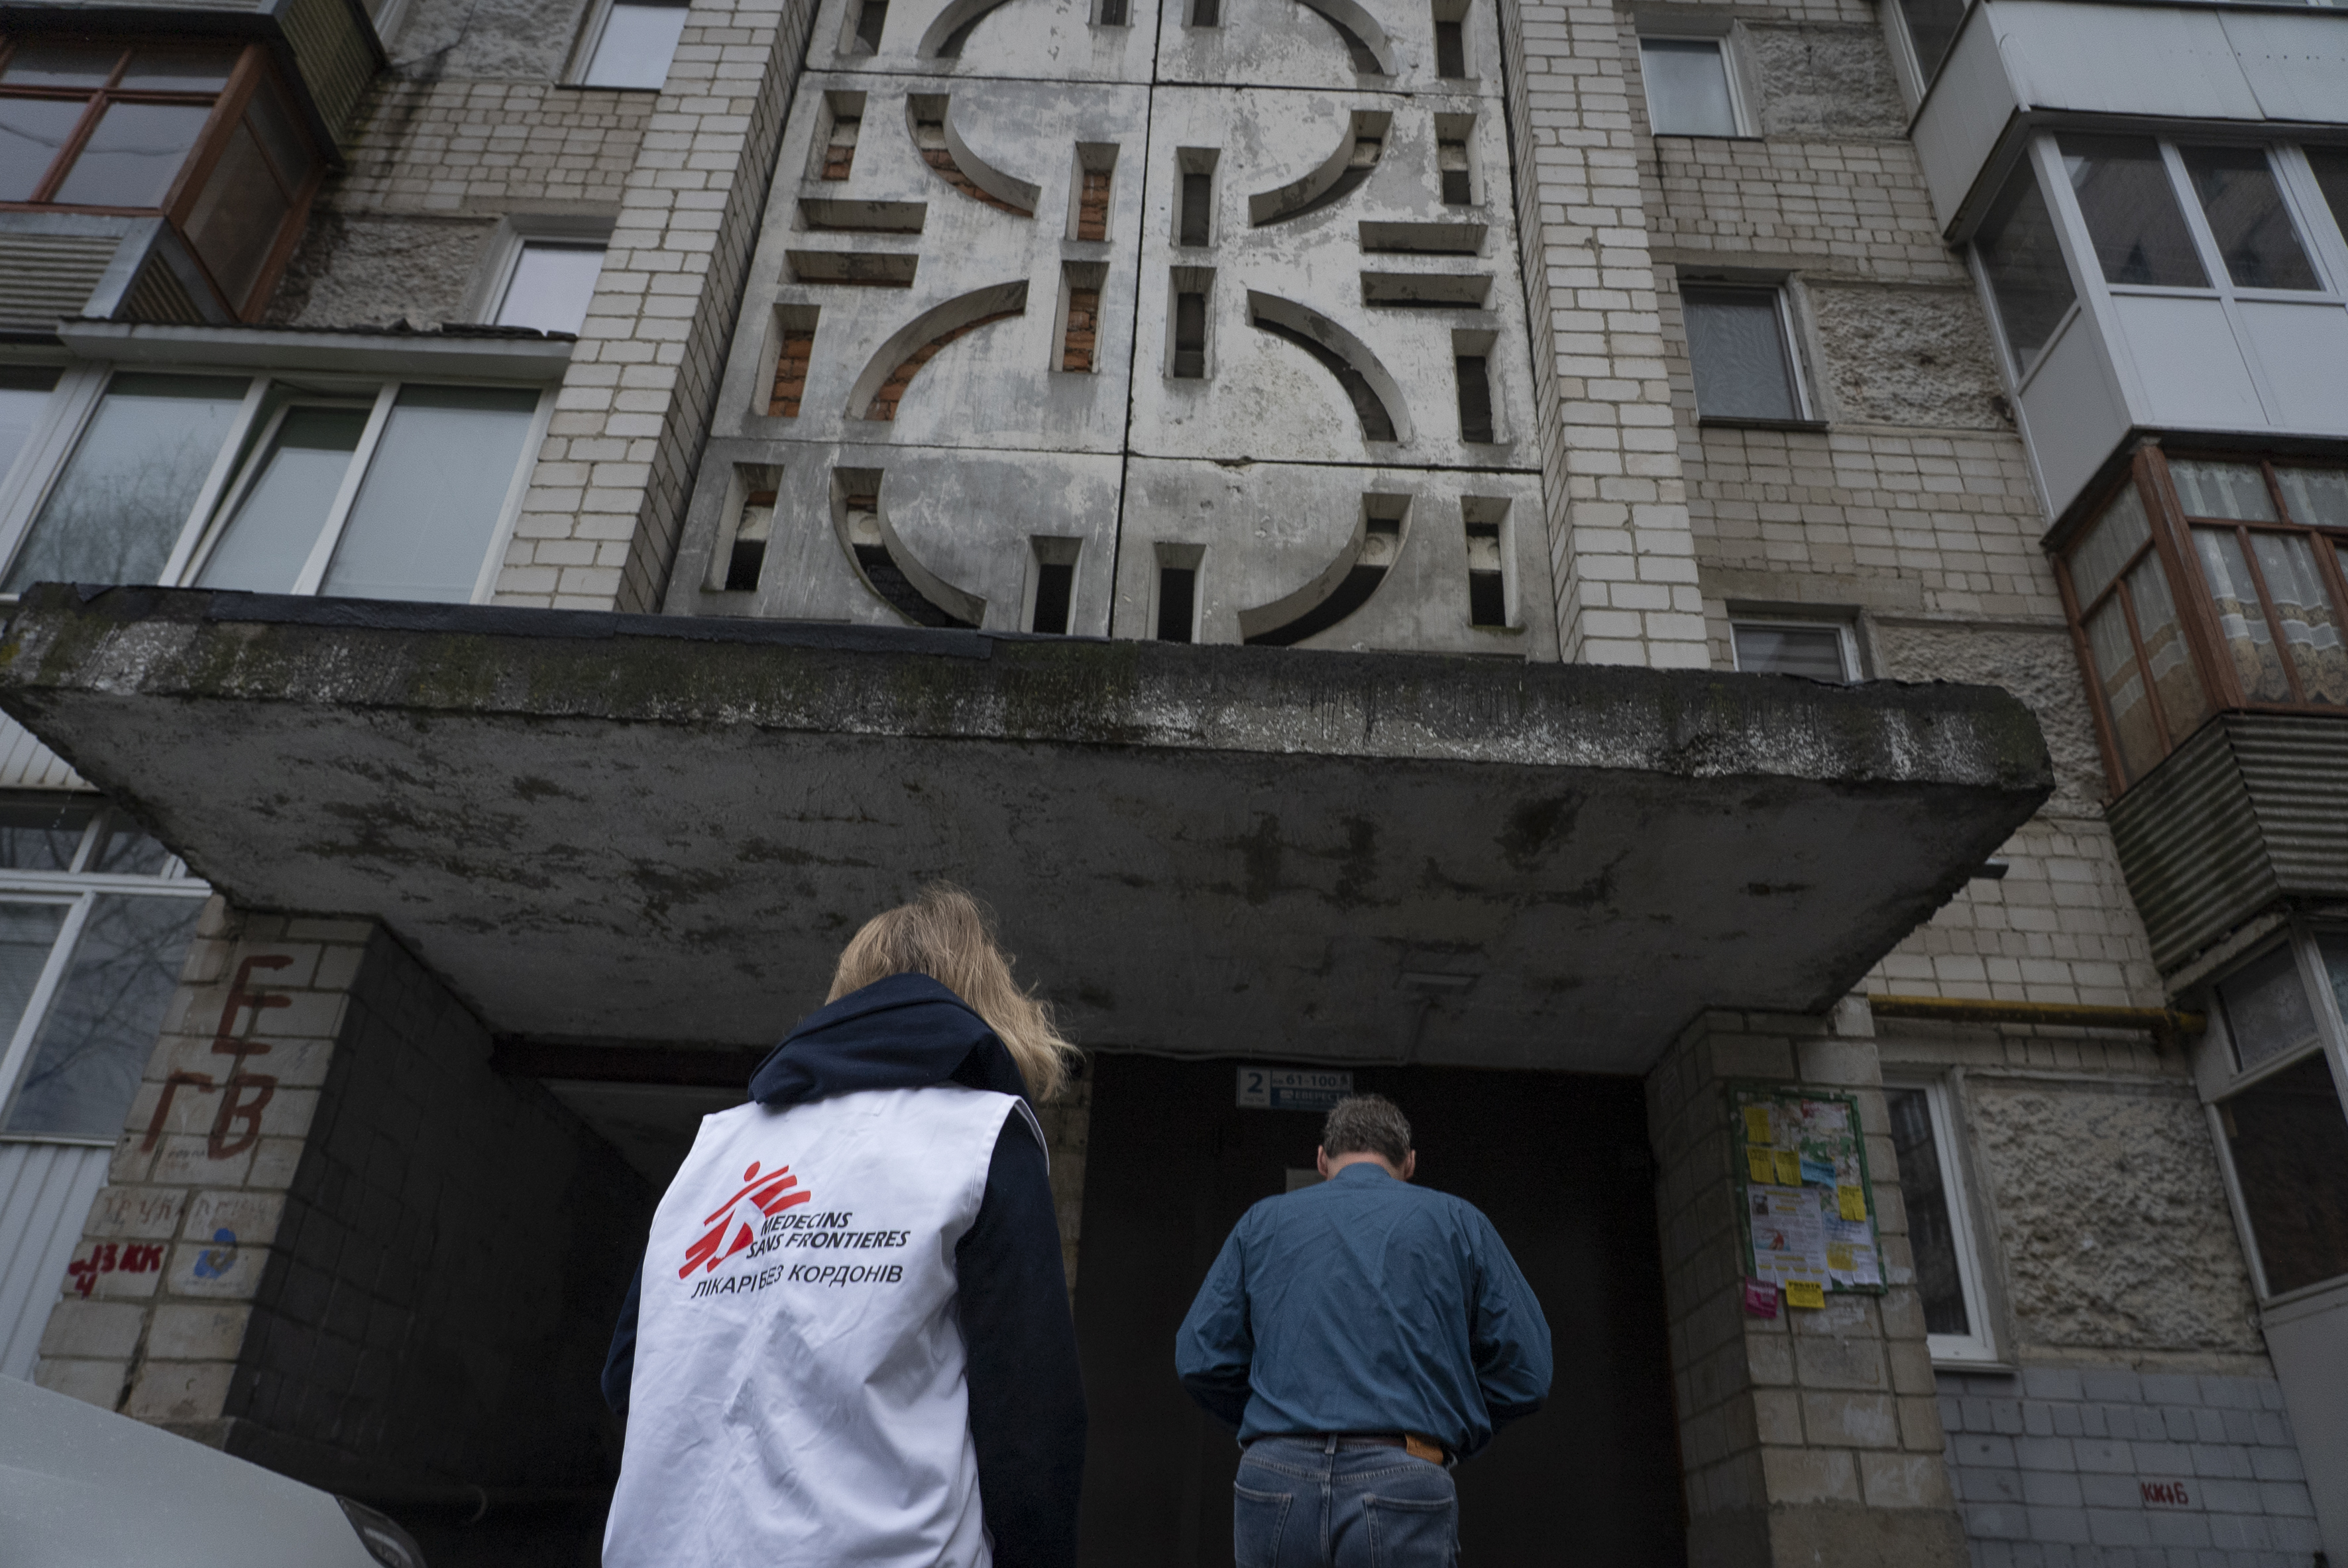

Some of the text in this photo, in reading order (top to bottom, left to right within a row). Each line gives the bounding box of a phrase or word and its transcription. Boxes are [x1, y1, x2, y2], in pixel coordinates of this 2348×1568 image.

[1247, 1072, 1263, 1093] 2
[760, 1212, 853, 1236] MEDECINS
[747, 1231, 911, 1259] SANS FRONTIERES
[691, 1264, 904, 1299] ЛІКАРІ БЕЗ КОРДОНІВ
